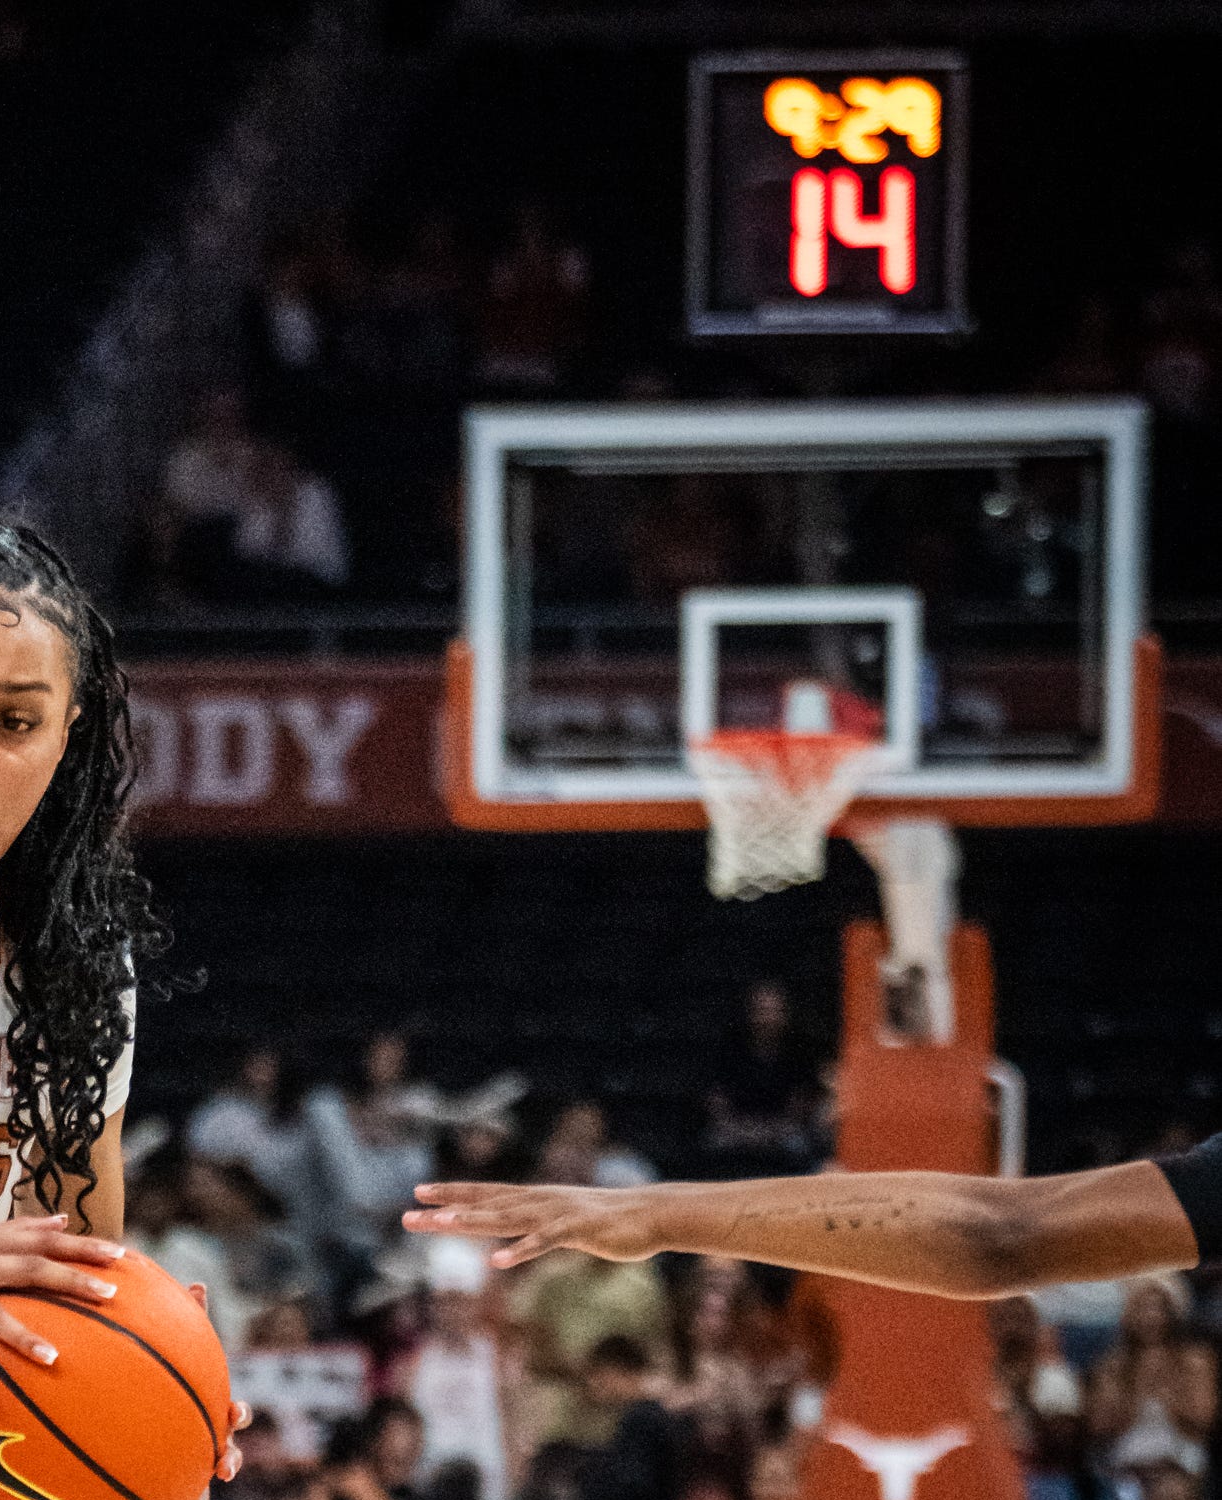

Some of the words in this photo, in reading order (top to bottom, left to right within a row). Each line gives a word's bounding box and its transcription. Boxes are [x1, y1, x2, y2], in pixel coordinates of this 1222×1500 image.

[763, 77, 942, 164] 9:29
[789, 165, 917, 298] 14
[124, 697, 376, 804] ODY
